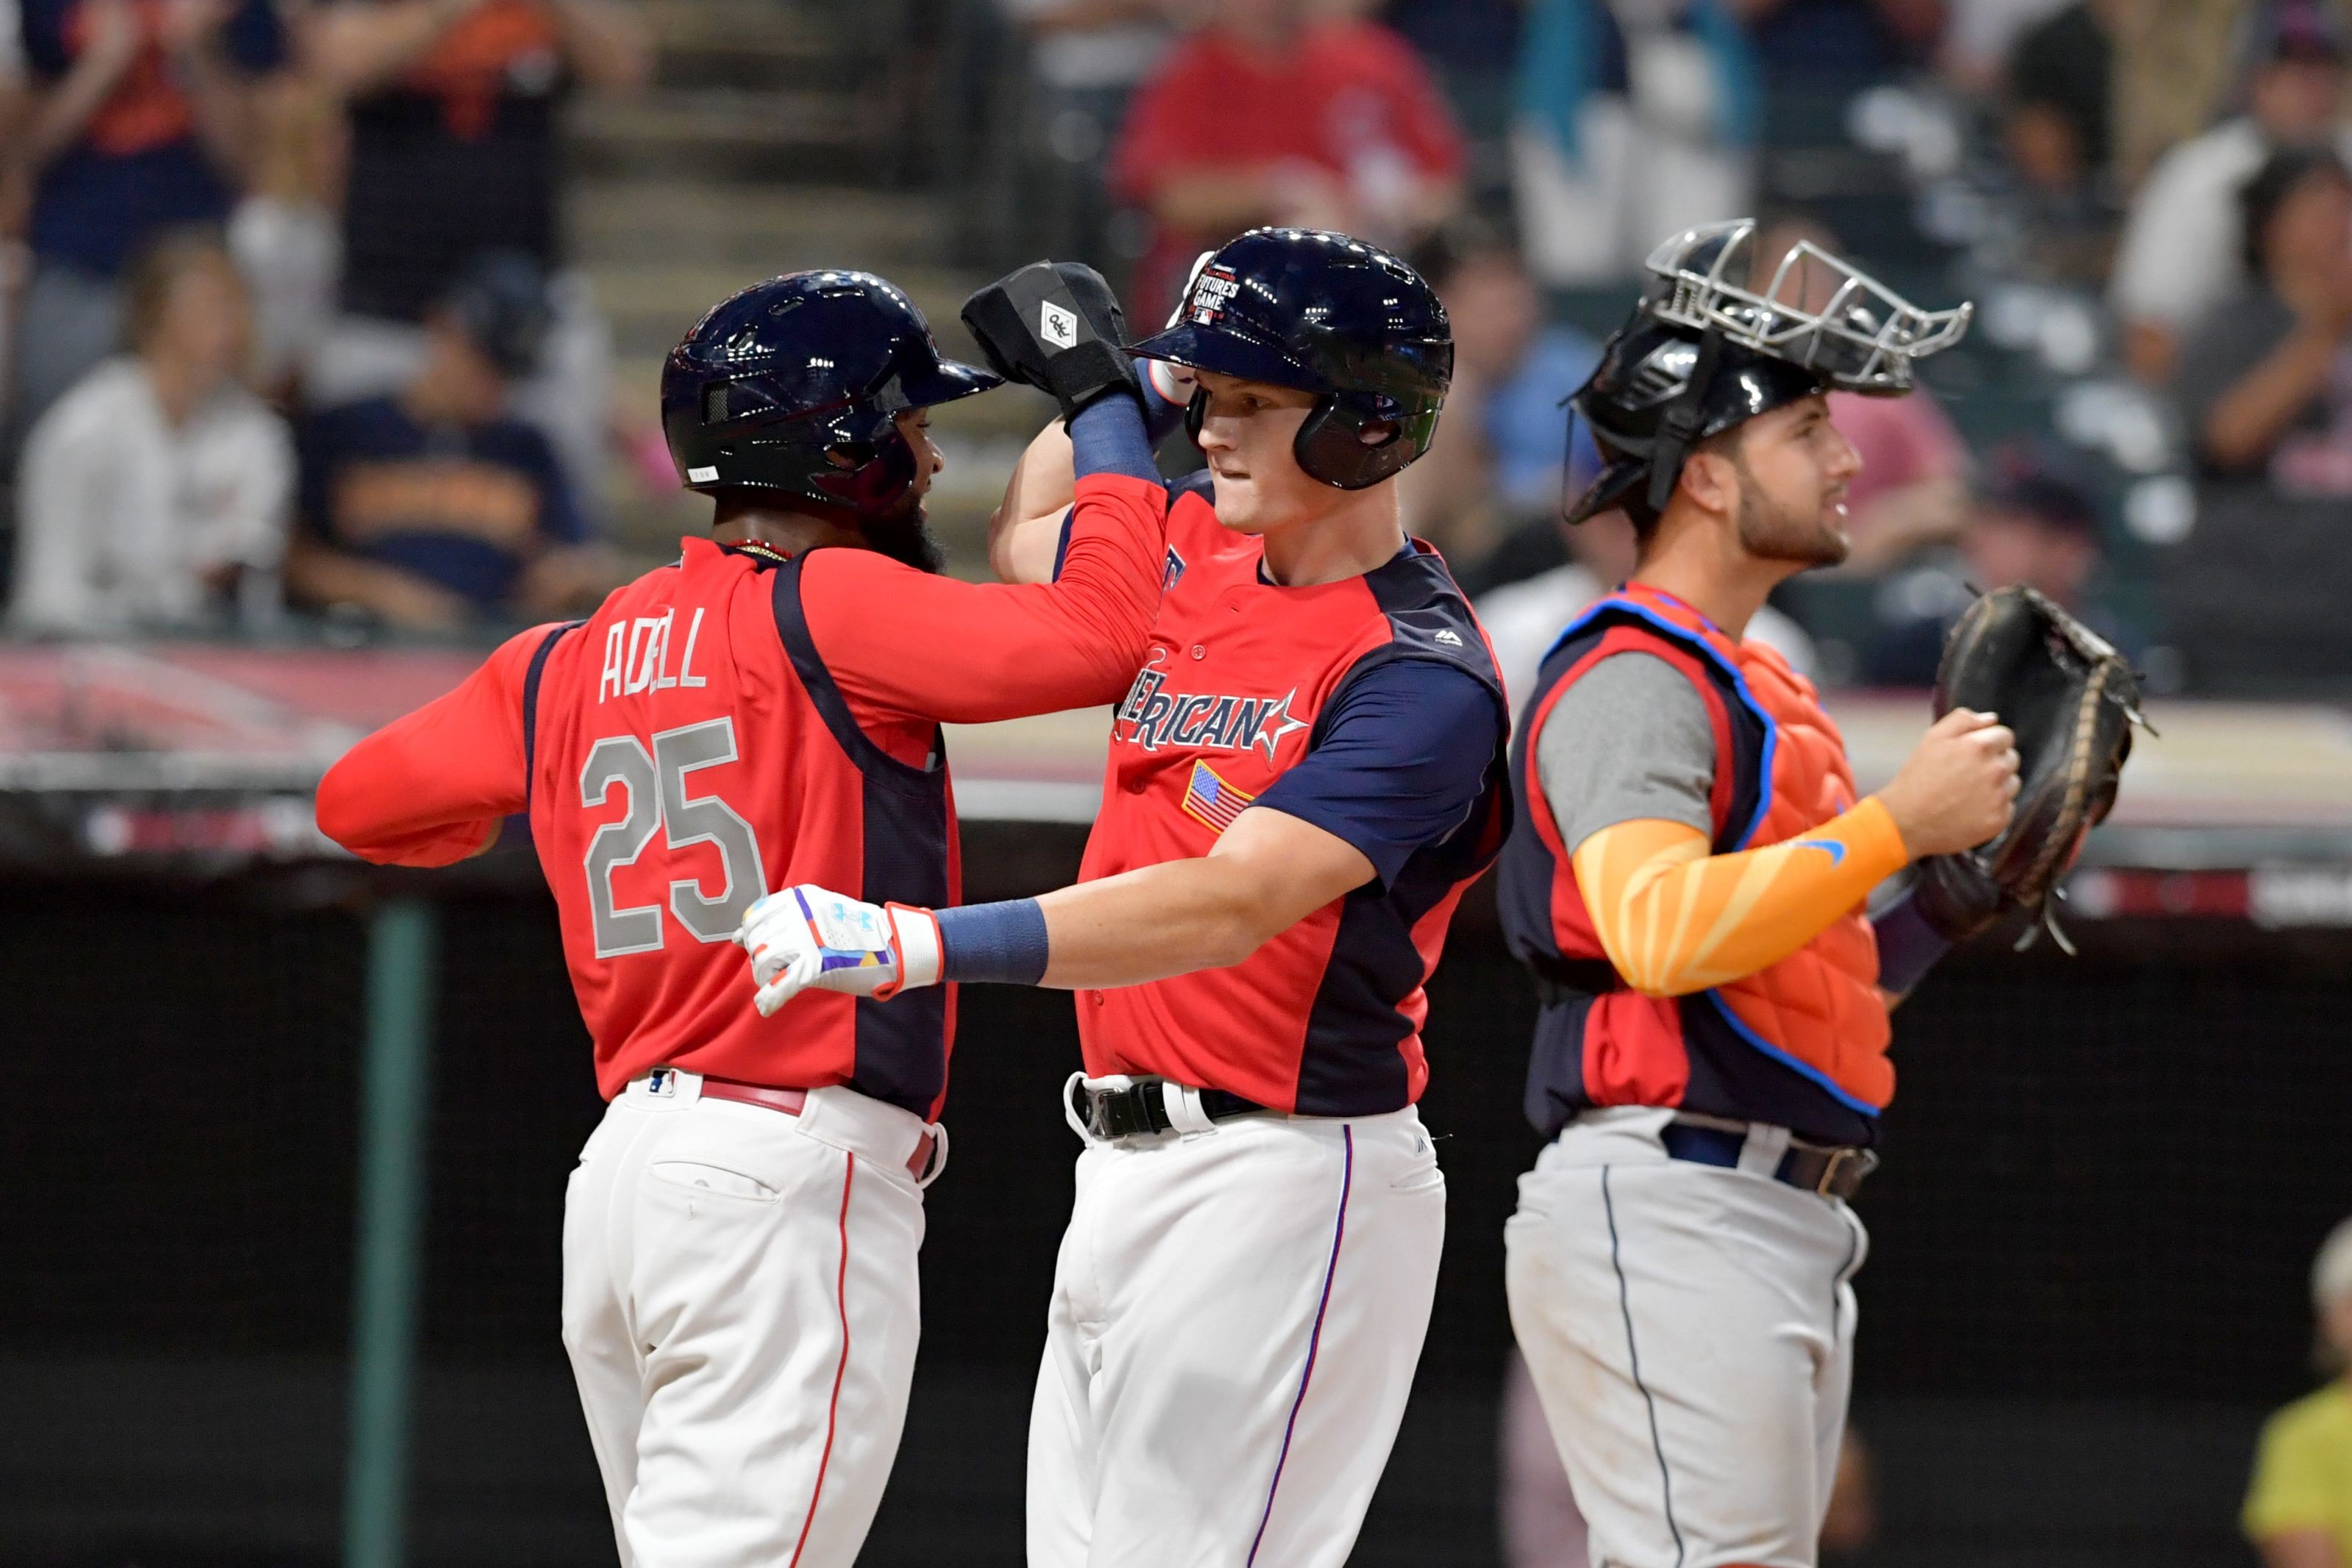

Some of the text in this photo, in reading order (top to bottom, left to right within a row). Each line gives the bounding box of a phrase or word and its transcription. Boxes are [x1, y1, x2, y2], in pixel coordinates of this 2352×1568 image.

[1194, 289, 1224, 311] GAME
[1195, 275, 1240, 298] FUTURES
[1116, 667, 1279, 752] ERICAN
[579, 716, 768, 959] 25
